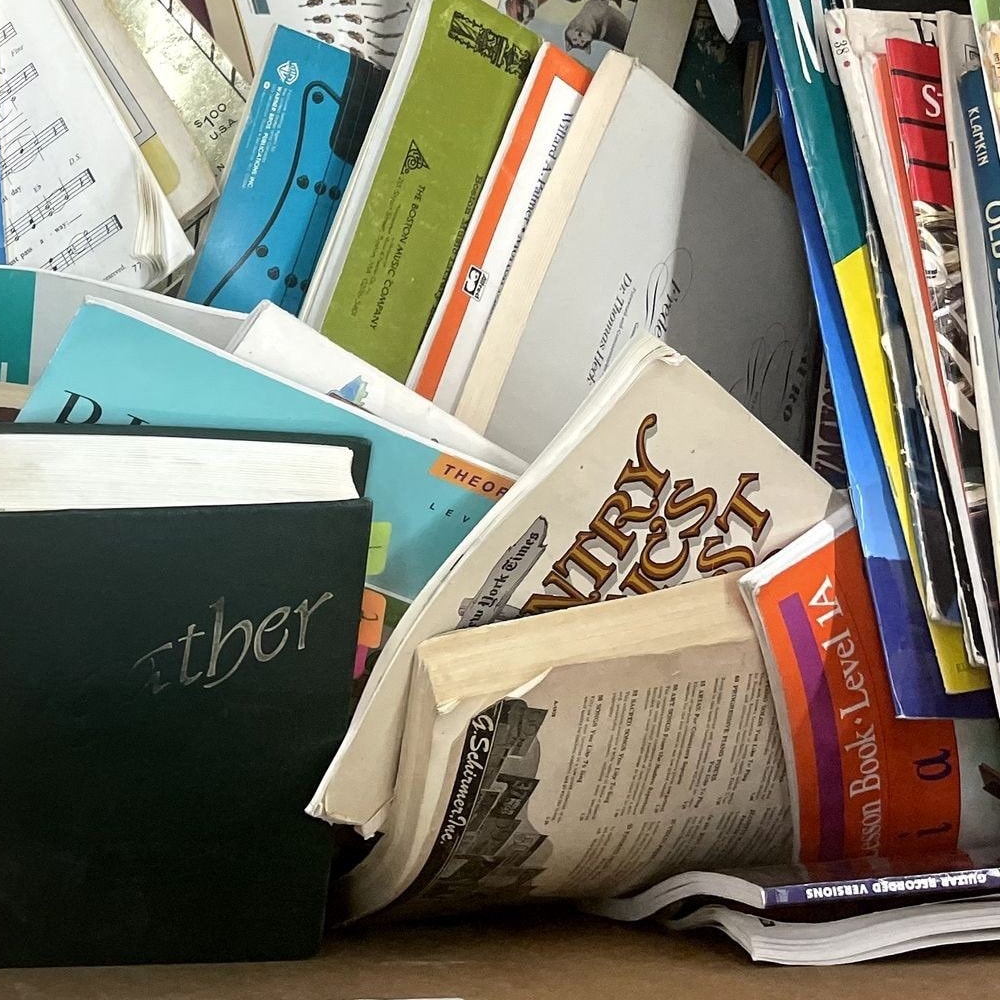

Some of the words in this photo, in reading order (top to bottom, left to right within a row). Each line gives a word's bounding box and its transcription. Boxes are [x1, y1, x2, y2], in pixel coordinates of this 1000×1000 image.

[193, 102, 229, 130] $100
[967, 106, 990, 168] KLAMKIN
[413, 184, 425, 201] THE
[399, 203, 418, 243] BOSTON
[388, 246, 403, 277] MUSIC
[619, 272, 630, 293] Dr.
[369, 279, 391, 329] COMPANY
[599, 296, 622, 350] Thomas
[586, 350, 602, 383] Heck
[428, 500, 471, 524] LEV
[502, 530, 541, 573] Times
[807, 574, 844, 628] 1A
[821, 627, 872, 722] Level
[845, 724, 880, 801] Book
[804, 883, 868, 899] VERSIONS
